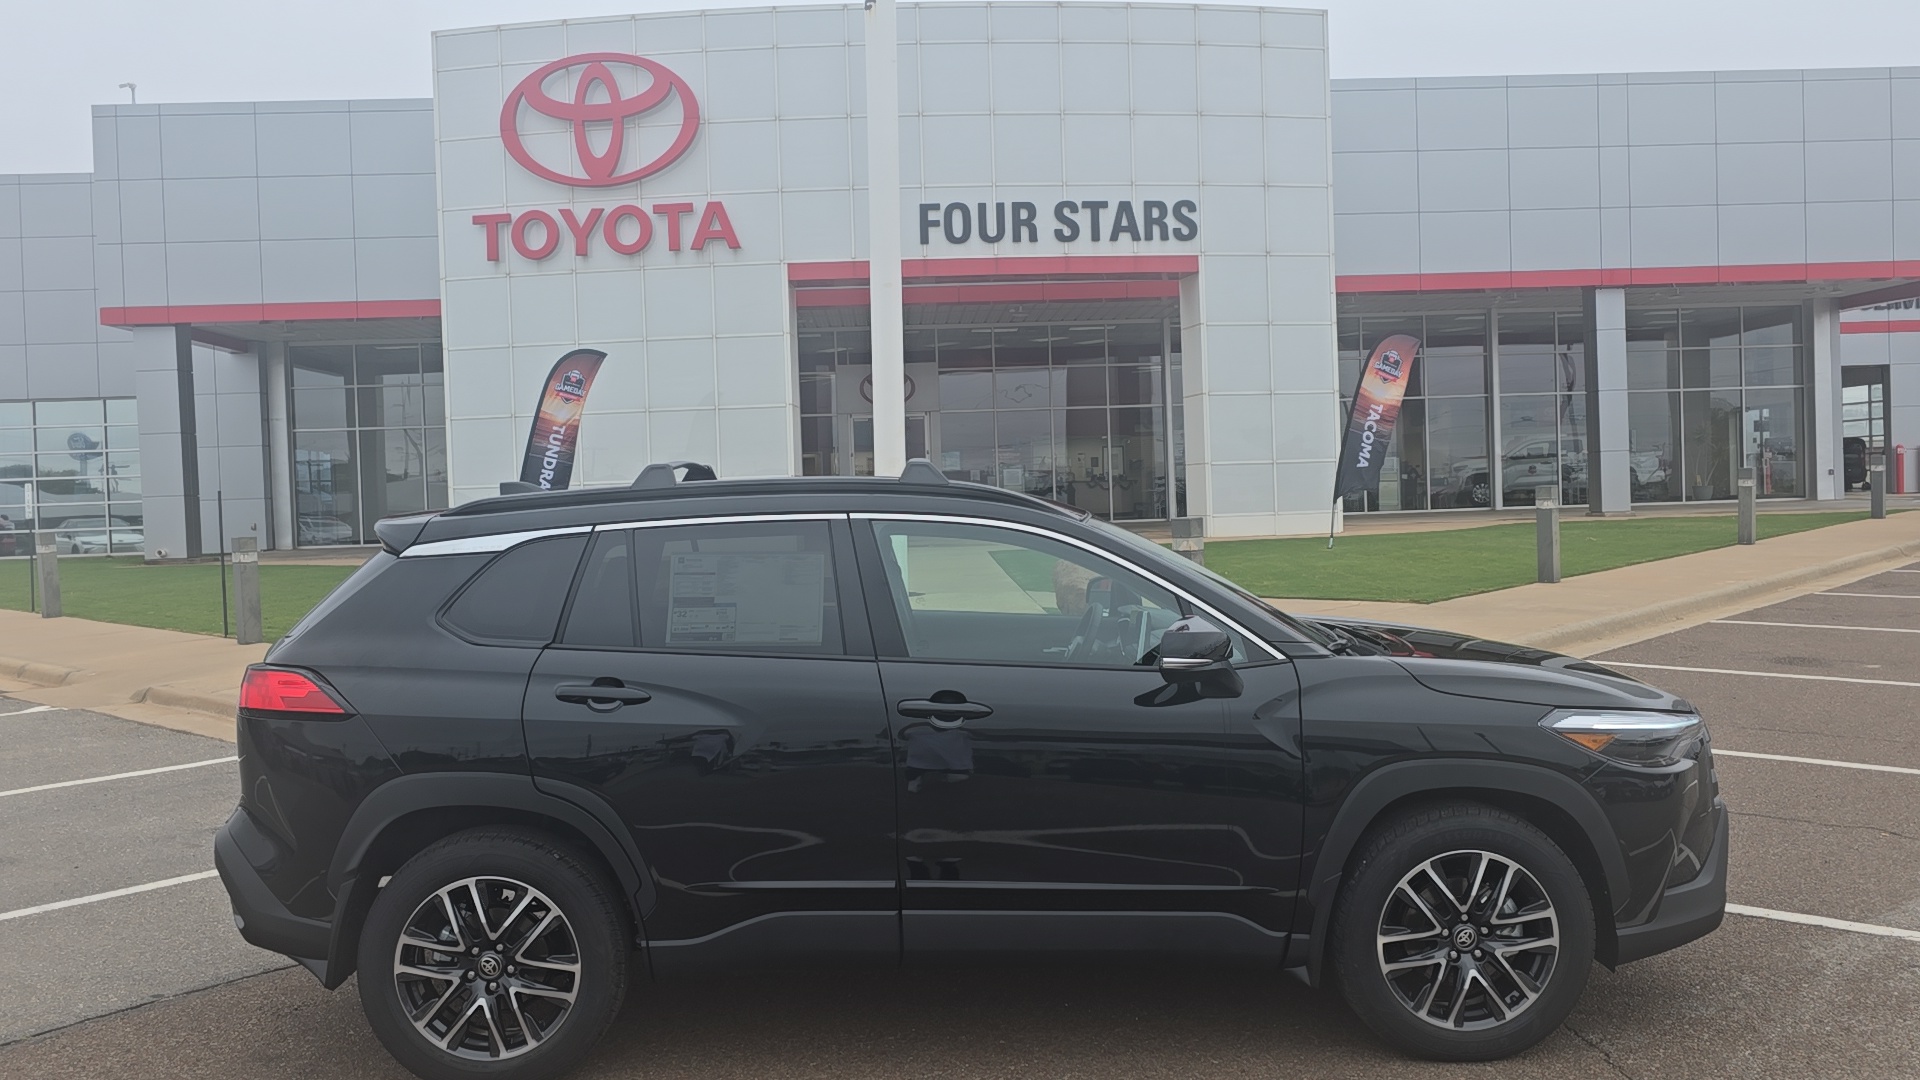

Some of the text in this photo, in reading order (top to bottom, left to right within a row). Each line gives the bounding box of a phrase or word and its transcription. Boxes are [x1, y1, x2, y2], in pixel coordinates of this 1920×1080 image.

[471, 201, 742, 262] TOYOTA
[919, 199, 1199, 245] FOUR STARS
[539, 425, 566, 491] TUNDRA
[1356, 403, 1384, 468] TACOMA
